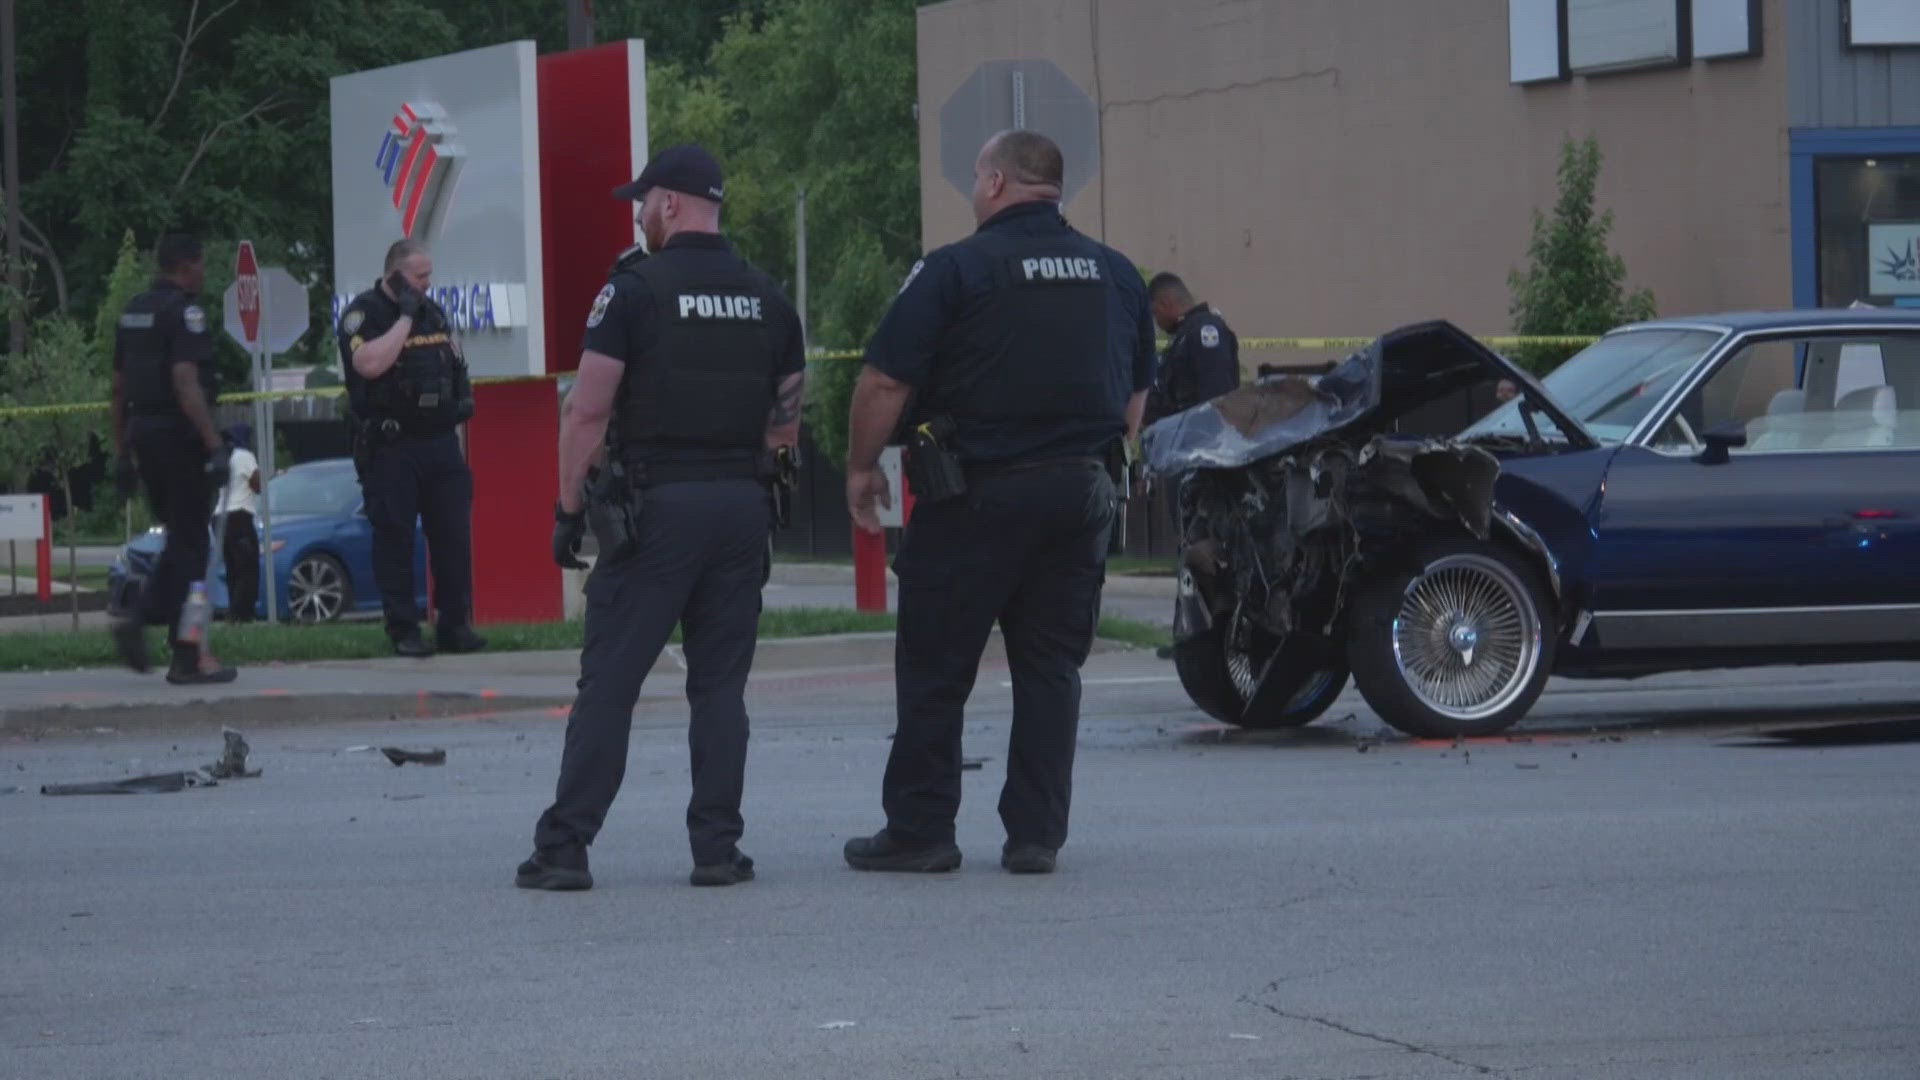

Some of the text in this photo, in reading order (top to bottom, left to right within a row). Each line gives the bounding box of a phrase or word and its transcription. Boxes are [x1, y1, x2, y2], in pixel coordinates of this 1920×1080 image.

[1022, 256, 1101, 281] POLICE
[238, 274, 259, 311] STOP
[678, 294, 762, 321] POLICE
